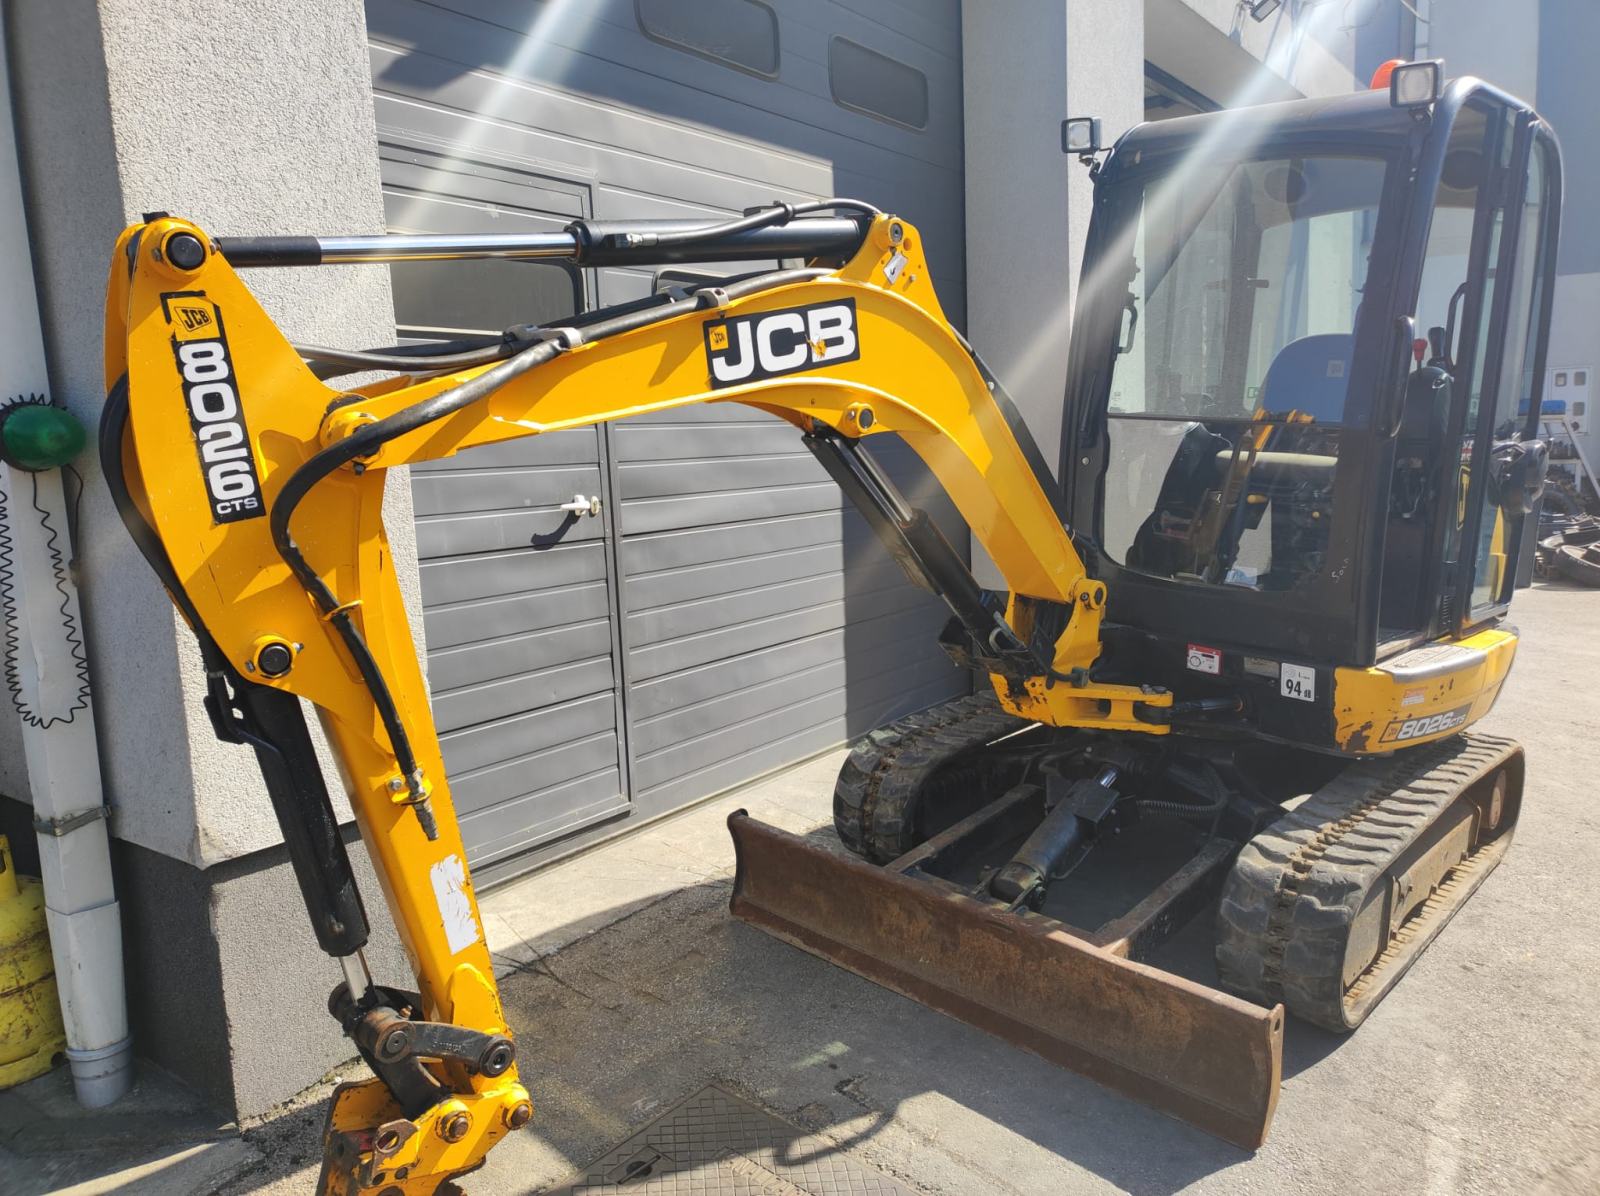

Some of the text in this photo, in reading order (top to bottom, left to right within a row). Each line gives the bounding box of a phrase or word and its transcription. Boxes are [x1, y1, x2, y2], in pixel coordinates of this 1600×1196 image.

[181, 308, 211, 331] JCB
[712, 305, 856, 381] JCB
[179, 341, 255, 500] 8026
[216, 497, 259, 515] CTS
[1285, 678, 1302, 696] 94
[1397, 711, 1454, 739] 8026
